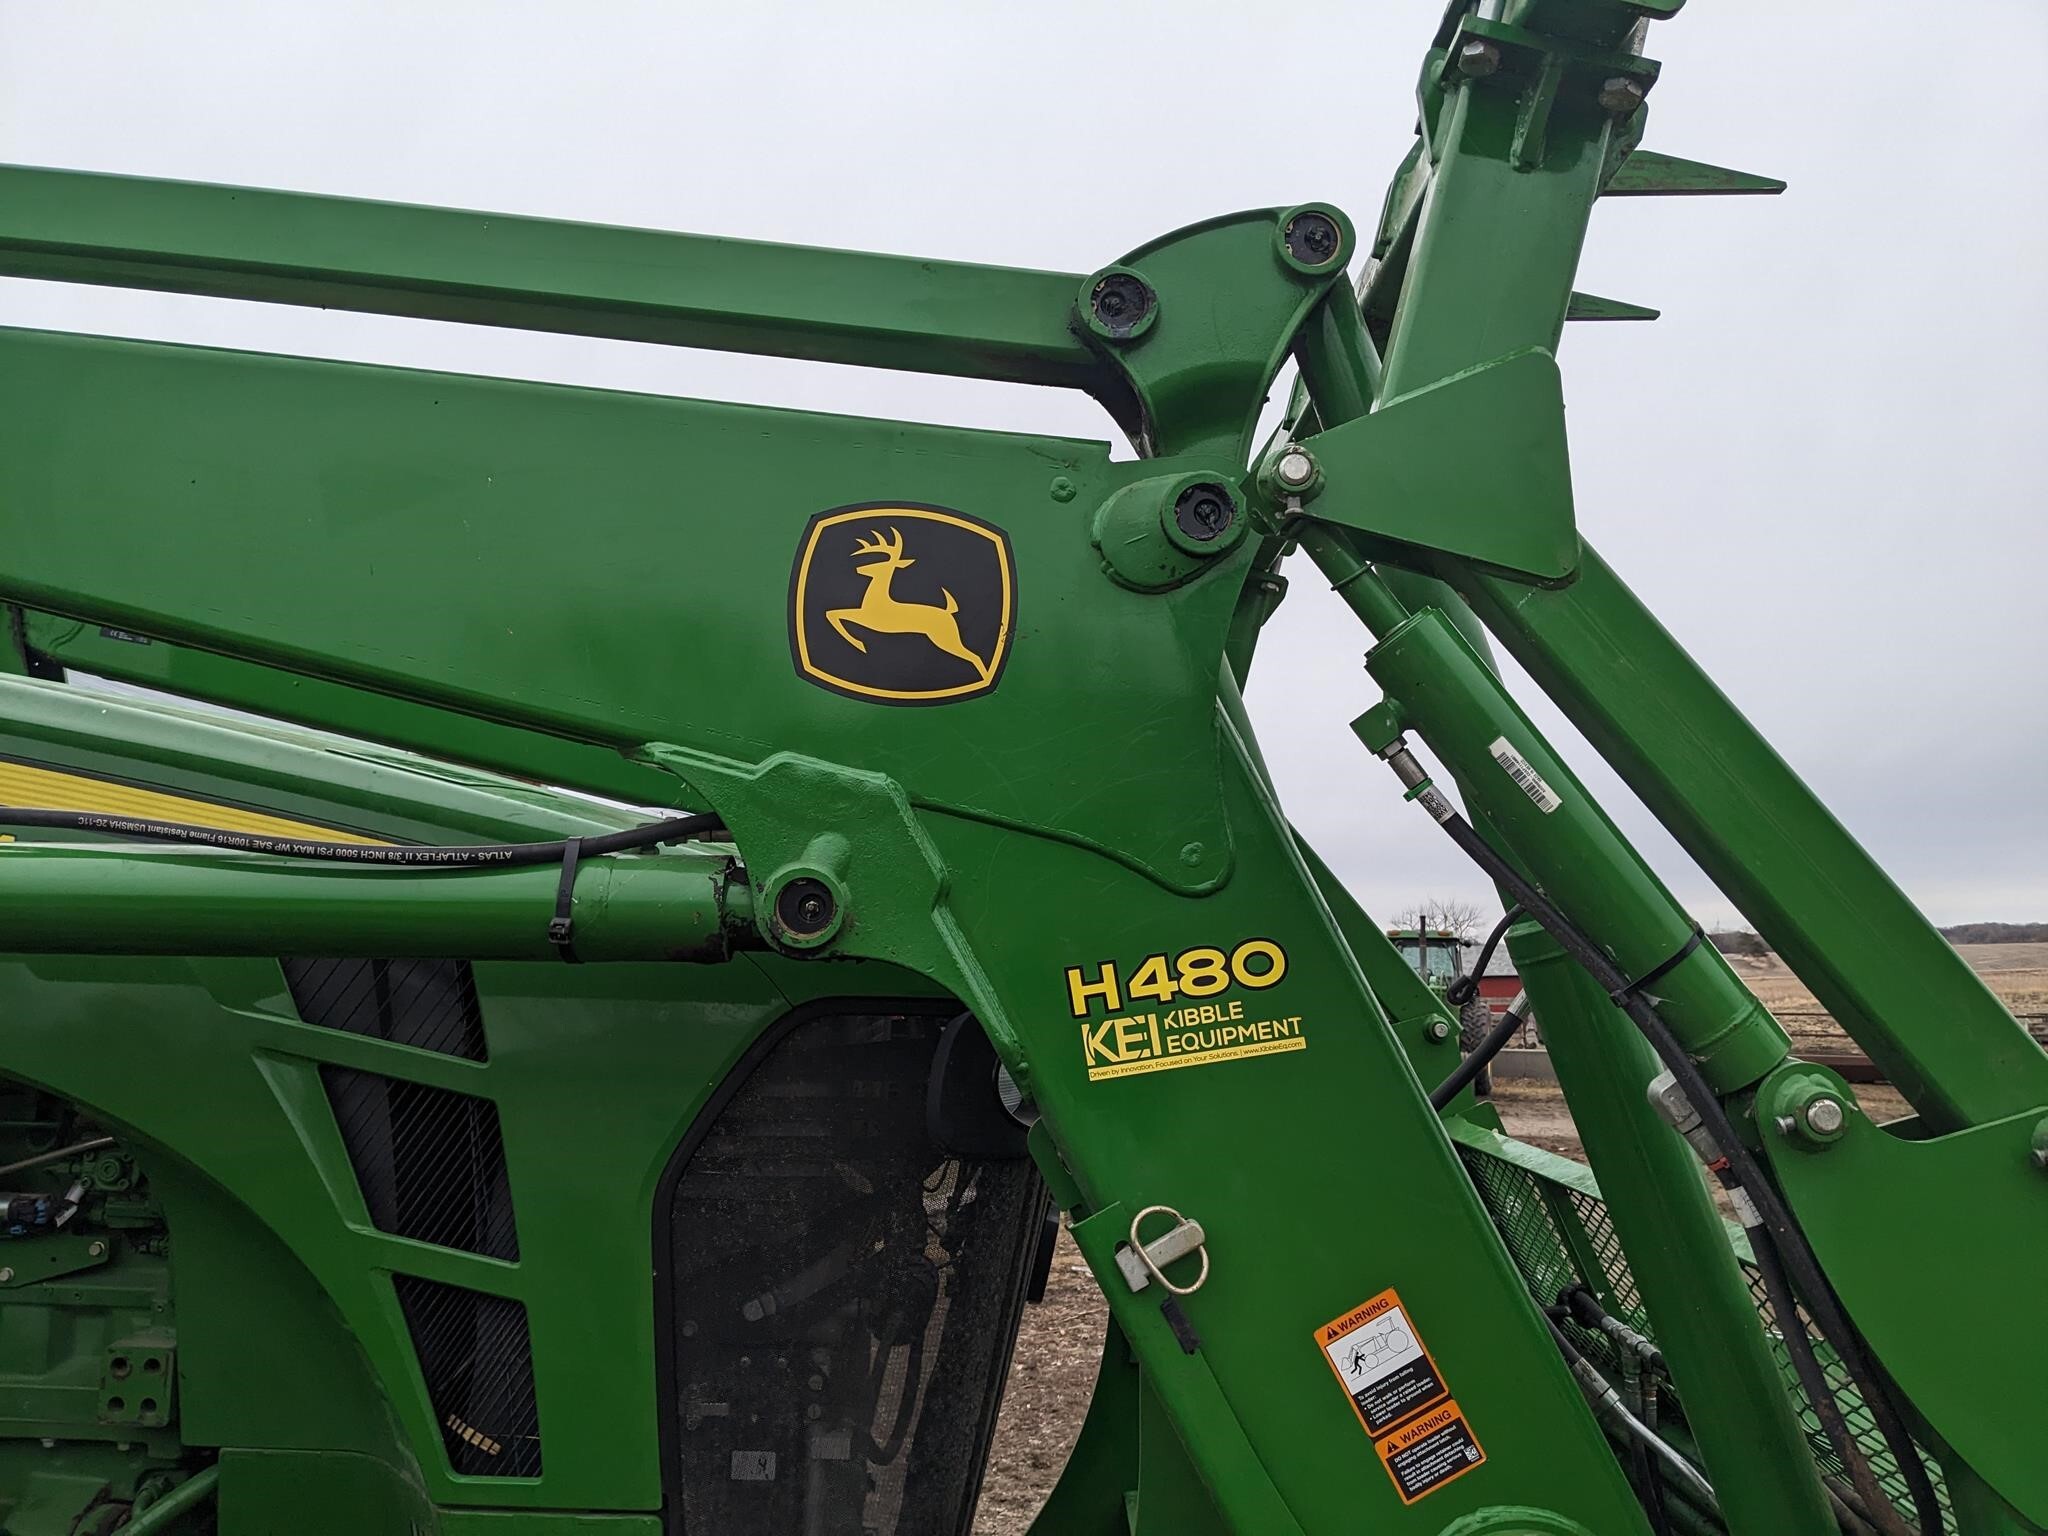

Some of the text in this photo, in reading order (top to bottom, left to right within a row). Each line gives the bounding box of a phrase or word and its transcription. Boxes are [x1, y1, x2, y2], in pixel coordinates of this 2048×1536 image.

[77, 815, 107, 828] 2G-11C
[147, 824, 187, 837] Resistant
[188, 828, 216, 842] Flame
[216, 834, 249, 846] 100R16
[251, 839, 272, 848] SAE
[274, 842, 290, 851] WP
[291, 842, 314, 855] MAX
[316, 846, 333, 855] PSI
[335, 848, 358, 857] 5000
[360, 849, 385, 859] INCH
[387, 851, 402, 860] 3/8
[478, 851, 511, 859] ATLAS
[415, 852, 468, 860] ATLAFLEX
[1066, 939, 1287, 1017] H480
[1163, 1000, 1244, 1030] KIBBLE
[1081, 1013, 1163, 1066] KEI
[1166, 1017, 1302, 1054] EQUIPMENT
[1090, 1069, 1110, 1078] Driven
[1155, 1057, 1182, 1068] Focused
[1338, 1298, 1390, 1332] WARNING
[1364, 1387, 1376, 1398] avoid
[1376, 1381, 1389, 1390] injury
[1388, 1375, 1400, 1383] from
[1399, 1367, 1414, 1377] falling
[1398, 1379, 1417, 1392] perform
[1370, 1403, 1386, 1414] service
[1386, 1395, 1398, 1405] under
[1402, 1385, 1416, 1395] raised
[1372, 1409, 1386, 1419] Lower
[1386, 1401, 1400, 1411] loader
[1406, 1388, 1422, 1401] ground
[1421, 1382, 1434, 1391] when
[1400, 1410, 1452, 1444] WARNING
[1401, 1450, 1411, 1458] NOT
[1411, 1442, 1428, 1453] operate
[1427, 1434, 1440, 1444] loader
[1440, 1425, 1456, 1436] without
[1397, 1455, 1417, 1468] engaging
[1416, 1441, 1440, 1457] attachment
[1401, 1466, 1416, 1476] Failure
[1420, 1454, 1436, 1465] engage
[1436, 1445, 1452, 1456] retainer
[1452, 1437, 1464, 1447] could
[1404, 1472, 1416, 1481] result
[1420, 1456, 1444, 1472] attachment
[1444, 1445, 1464, 1458] detaching
[1406, 1478, 1417, 1486] from
[1416, 1470, 1430, 1480] loader
[1430, 1461, 1447, 1473] causing
[1446, 1453, 1462, 1463] serious
[1409, 1482, 1422, 1491] bodily
[1422, 1475, 1434, 1484] injury
